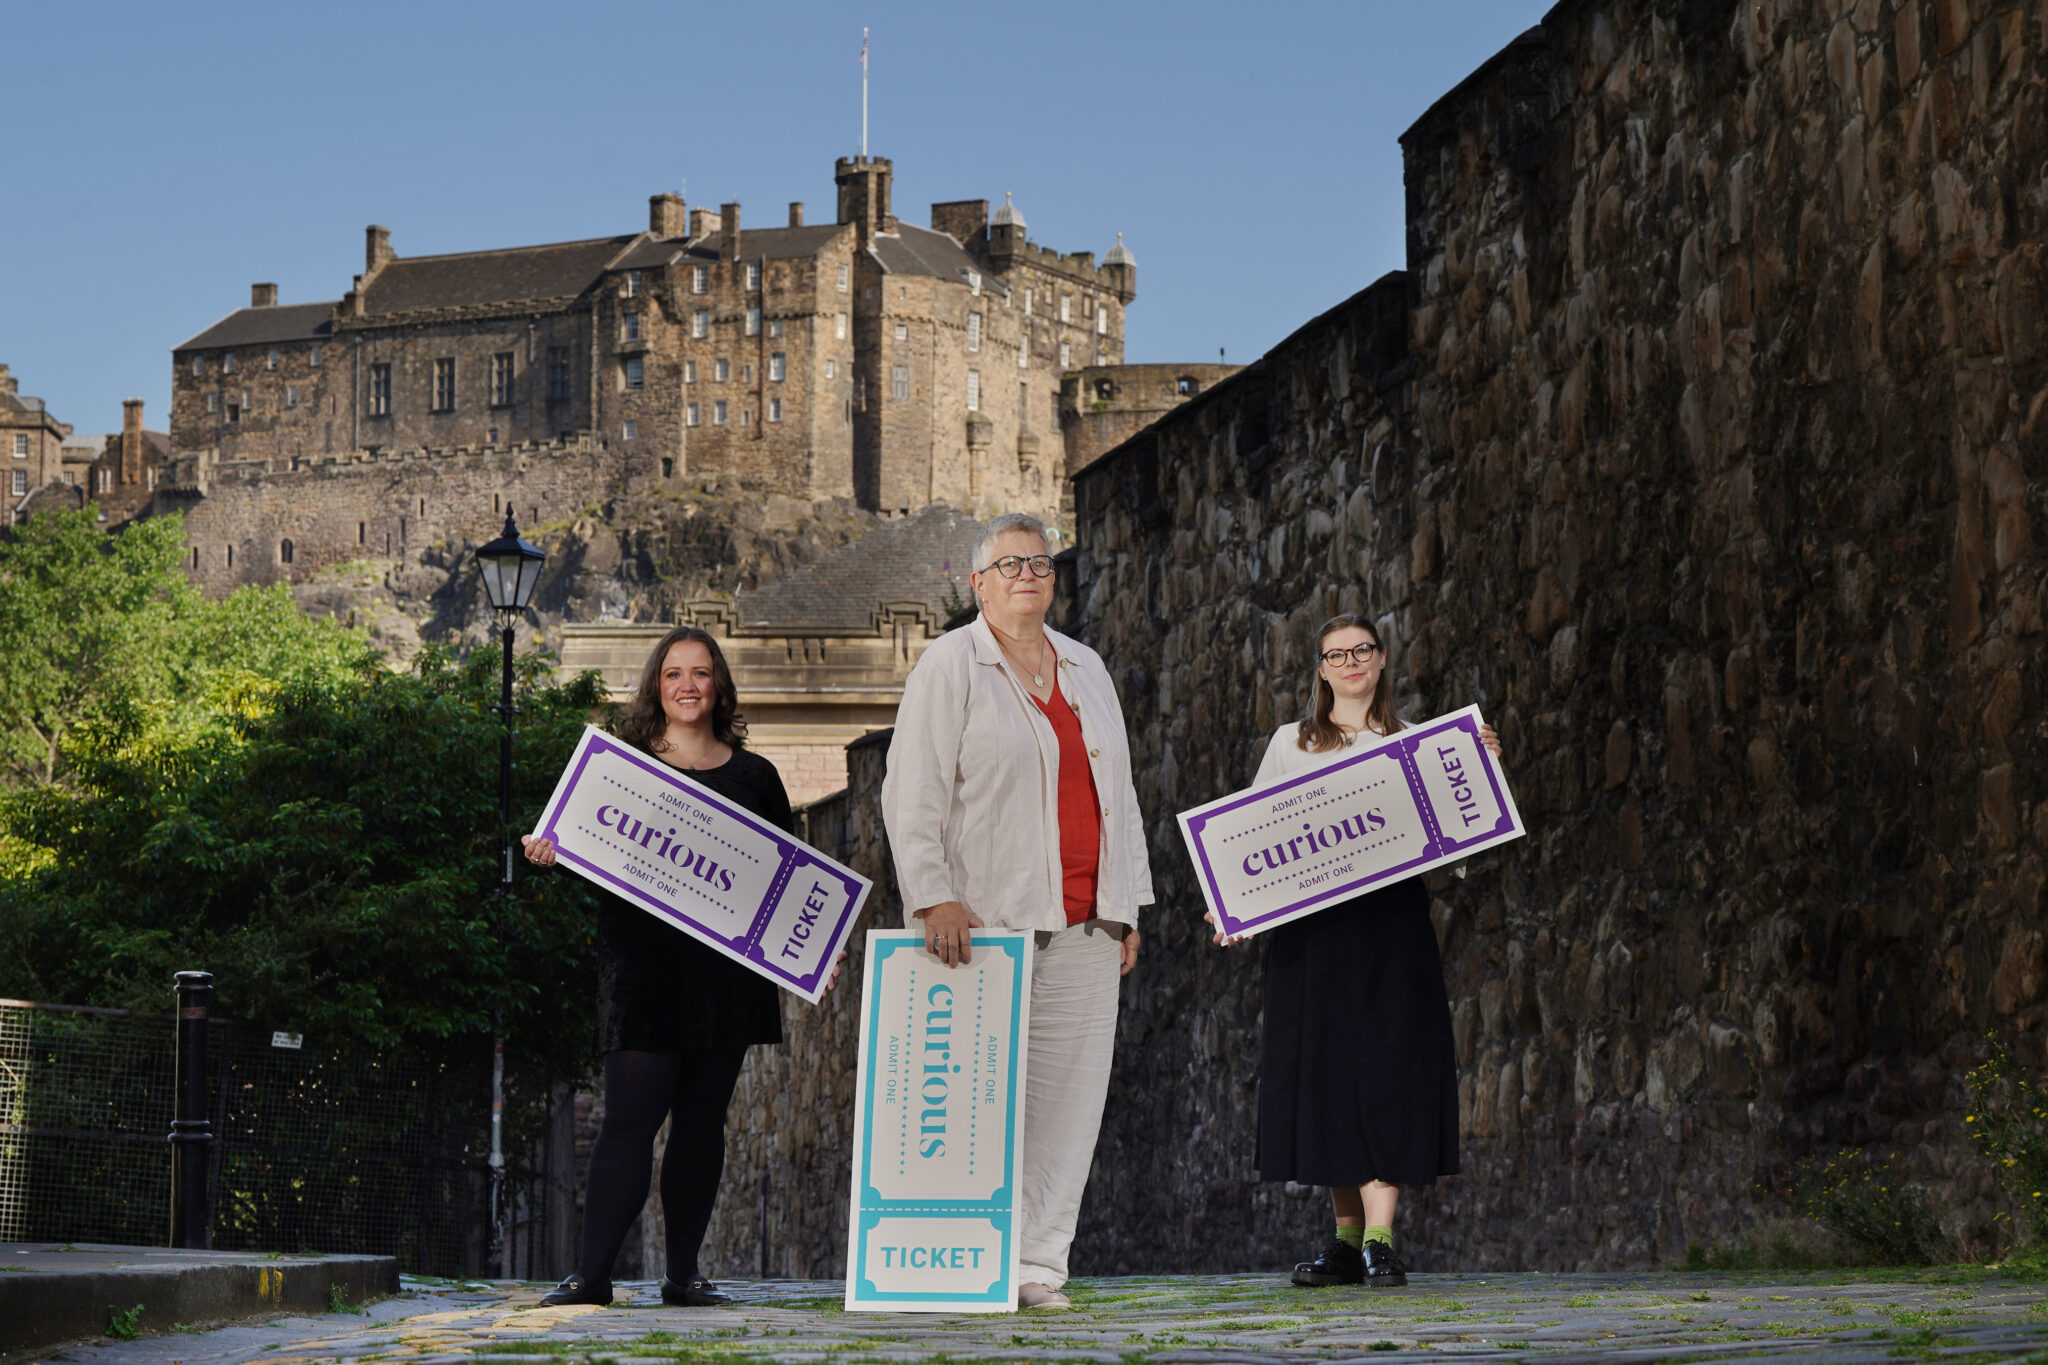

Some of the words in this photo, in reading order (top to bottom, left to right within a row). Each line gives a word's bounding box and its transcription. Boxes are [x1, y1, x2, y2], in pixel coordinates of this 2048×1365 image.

[1271, 794, 1303, 814] ADMIT
[1305, 786, 1328, 802] ONE
[1436, 745, 1481, 828] TICKET
[658, 791, 692, 815] ADMIT
[692, 809, 714, 826] ONE
[596, 805, 736, 892] curious
[1242, 807, 1386, 877] curious
[622, 862, 656, 887] ADMIT
[656, 880, 678, 898] ONE
[1298, 870, 1331, 891] ADMIT
[1332, 862, 1354, 878] ONE
[780, 880, 830, 961] TICKET
[887, 1035, 900, 1075] ADMIT
[919, 983, 961, 1159] curious
[986, 1035, 998, 1076] ADMIT
[886, 1079, 897, 1105] ONE
[984, 1079, 996, 1105] ONE
[880, 1246, 985, 1269] TICKET
